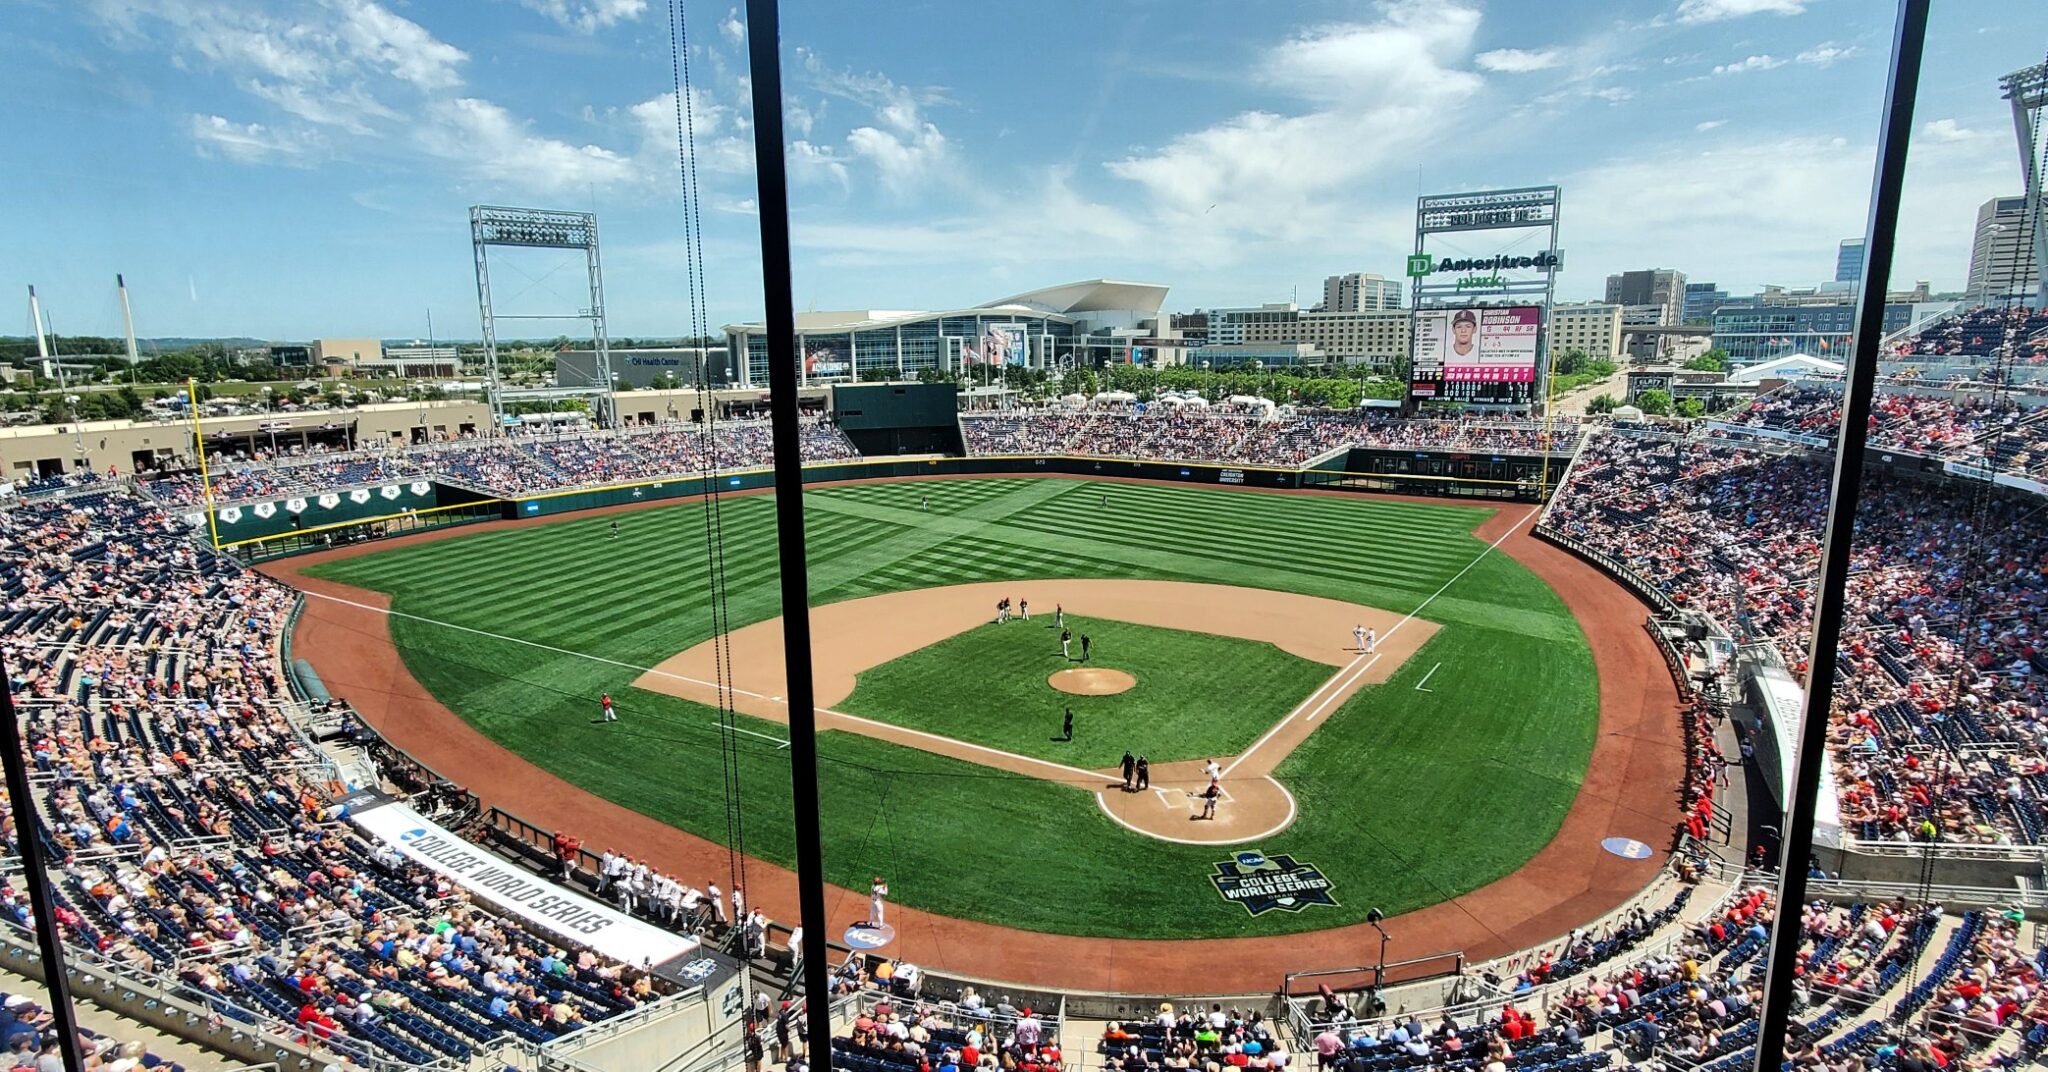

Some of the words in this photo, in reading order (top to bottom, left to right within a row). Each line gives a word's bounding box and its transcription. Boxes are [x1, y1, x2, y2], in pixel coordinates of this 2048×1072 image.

[1410, 258, 1428, 273] TD
[1438, 252, 1558, 273] Ameritrade
[1482, 315, 1521, 325] ROBINSON
[408, 835, 487, 873] COLLEGE
[468, 866, 545, 902] WORLD
[527, 895, 614, 934] SERIES
[1225, 885, 1276, 899] WORLD
[1277, 878, 1328, 893] SERIES
[1239, 873, 1301, 888] COLLEGE
[1267, 892, 1299, 900] OMAHA
